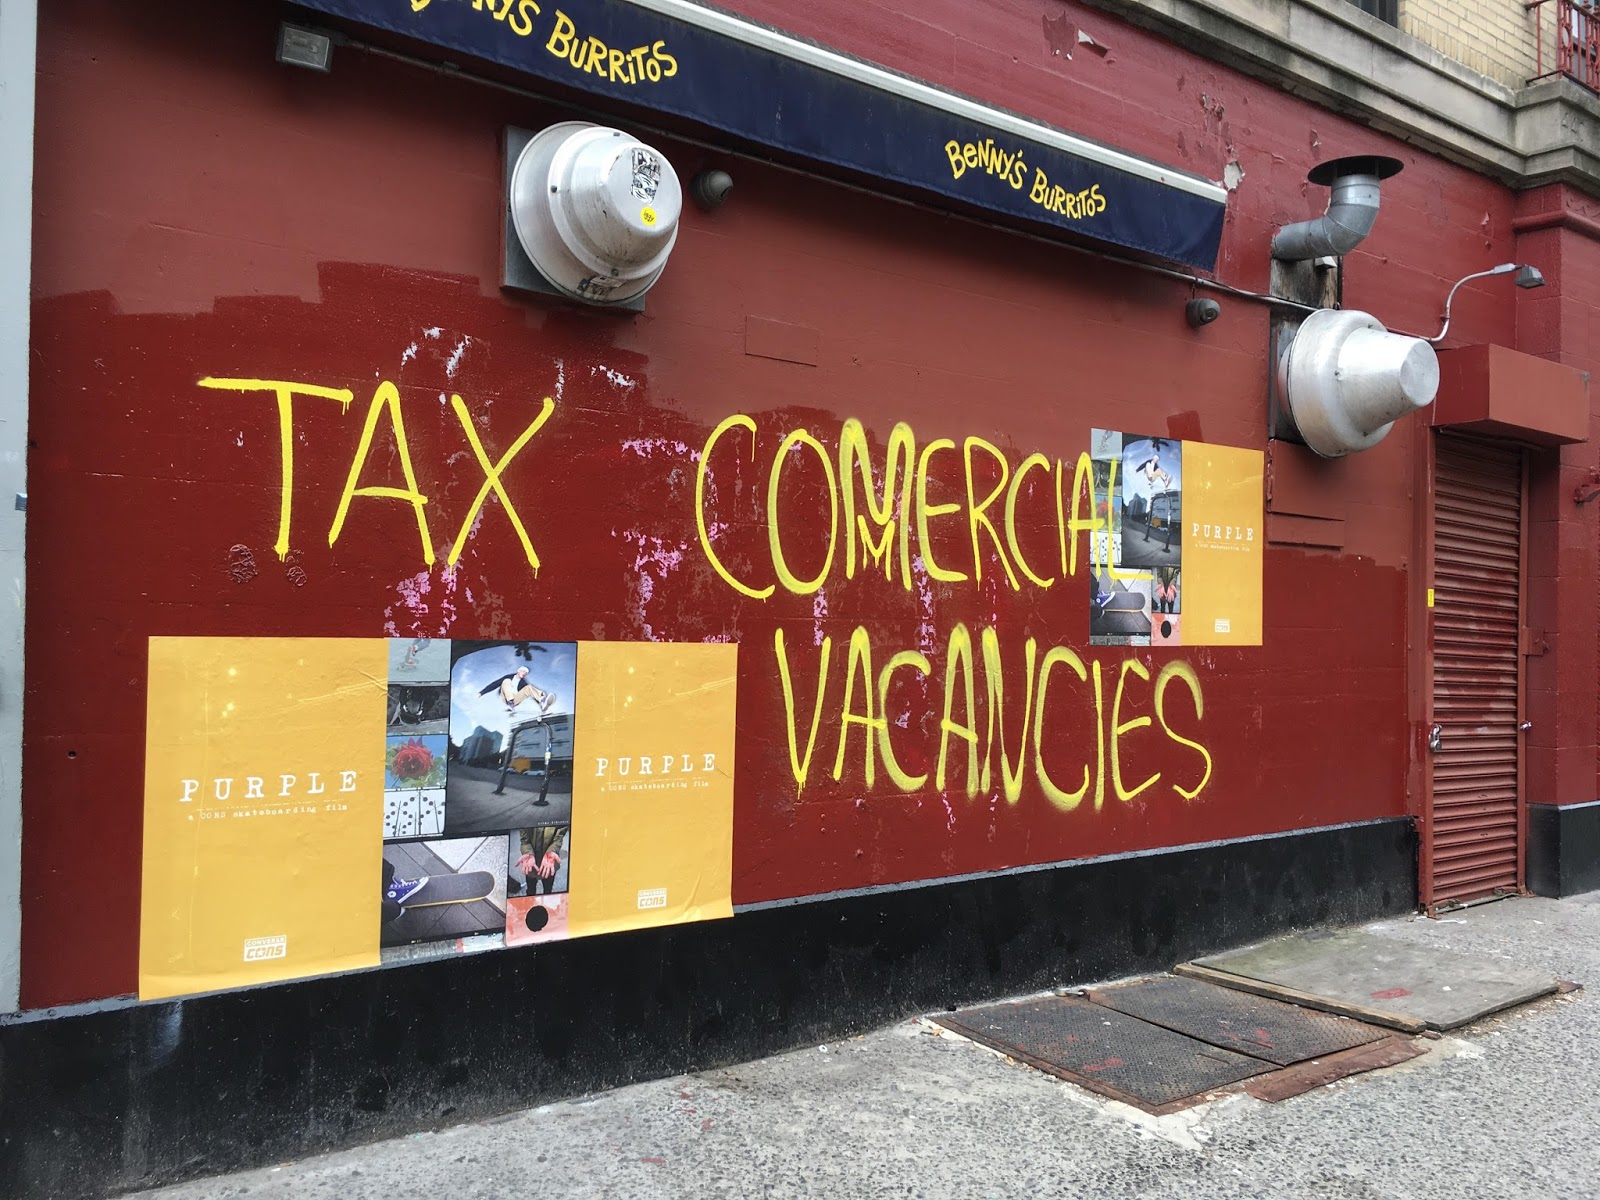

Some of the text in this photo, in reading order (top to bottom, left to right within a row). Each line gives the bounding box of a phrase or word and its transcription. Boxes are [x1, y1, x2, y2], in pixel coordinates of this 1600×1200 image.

[197, 380, 554, 577] TAX
[1191, 522, 1254, 541] PURPLE
[774, 622, 1213, 811] VACANCIES
[595, 753, 716, 777] PURPLE
[179, 770, 358, 802] PURPLE
[630, 781, 688, 791] skateboarding
[187, 803, 348, 821] a CONS skateboarding film
[246, 944, 285, 959] CONS
